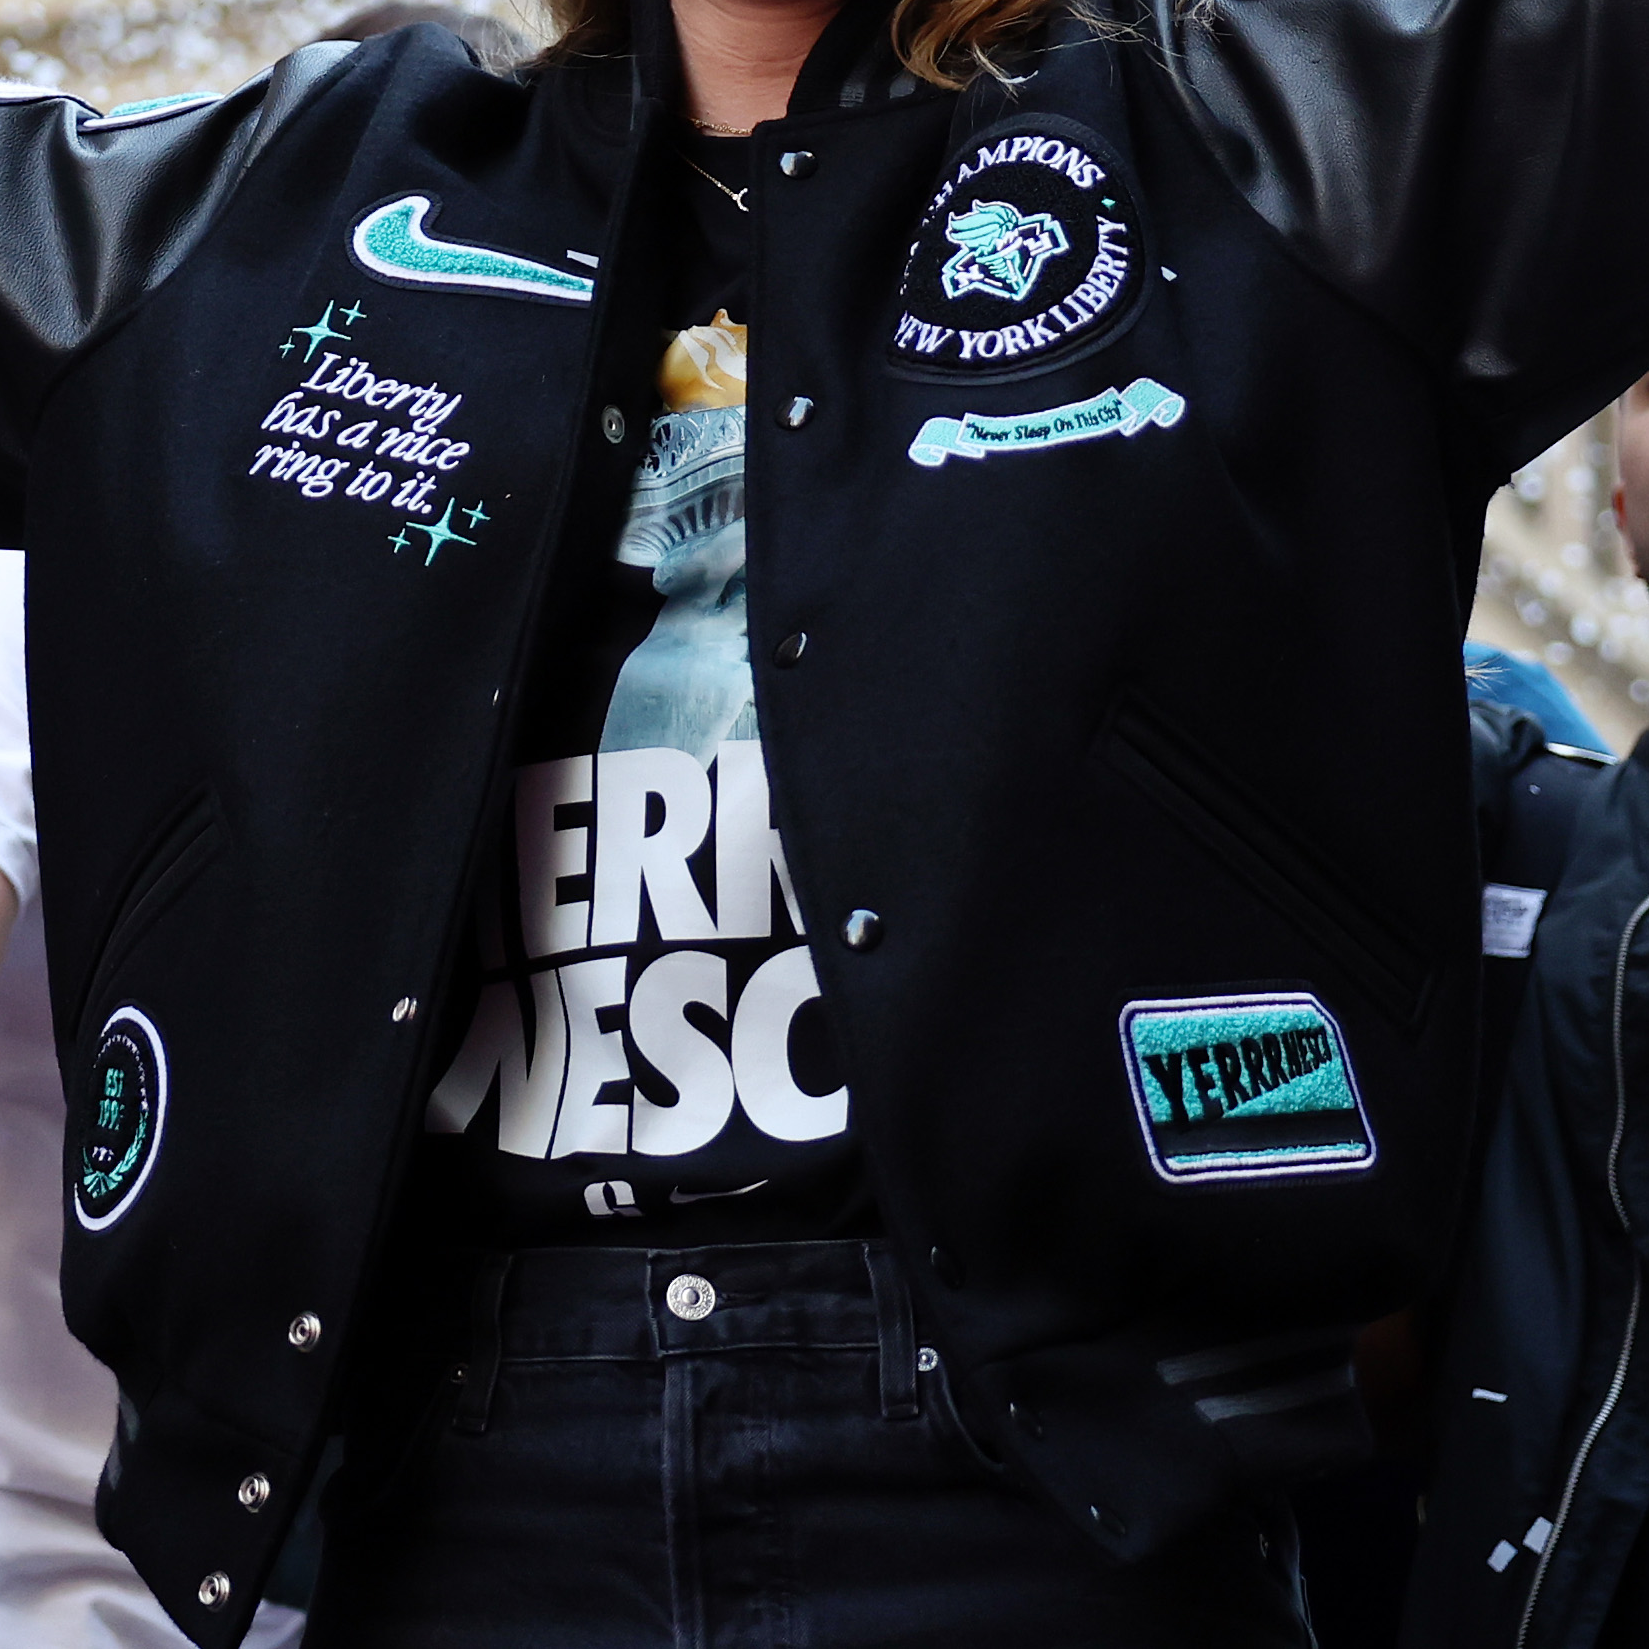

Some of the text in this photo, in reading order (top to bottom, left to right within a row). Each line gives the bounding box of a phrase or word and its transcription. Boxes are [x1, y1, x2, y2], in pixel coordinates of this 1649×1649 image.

[958, 314, 1061, 359] YORK
[1049, 215, 1130, 333] LIBERTY
[260, 391, 470, 470] has a nice
[300, 351, 463, 433] Liberty
[1053, 417, 1075, 433] On
[249, 440, 437, 514] ring to it.
